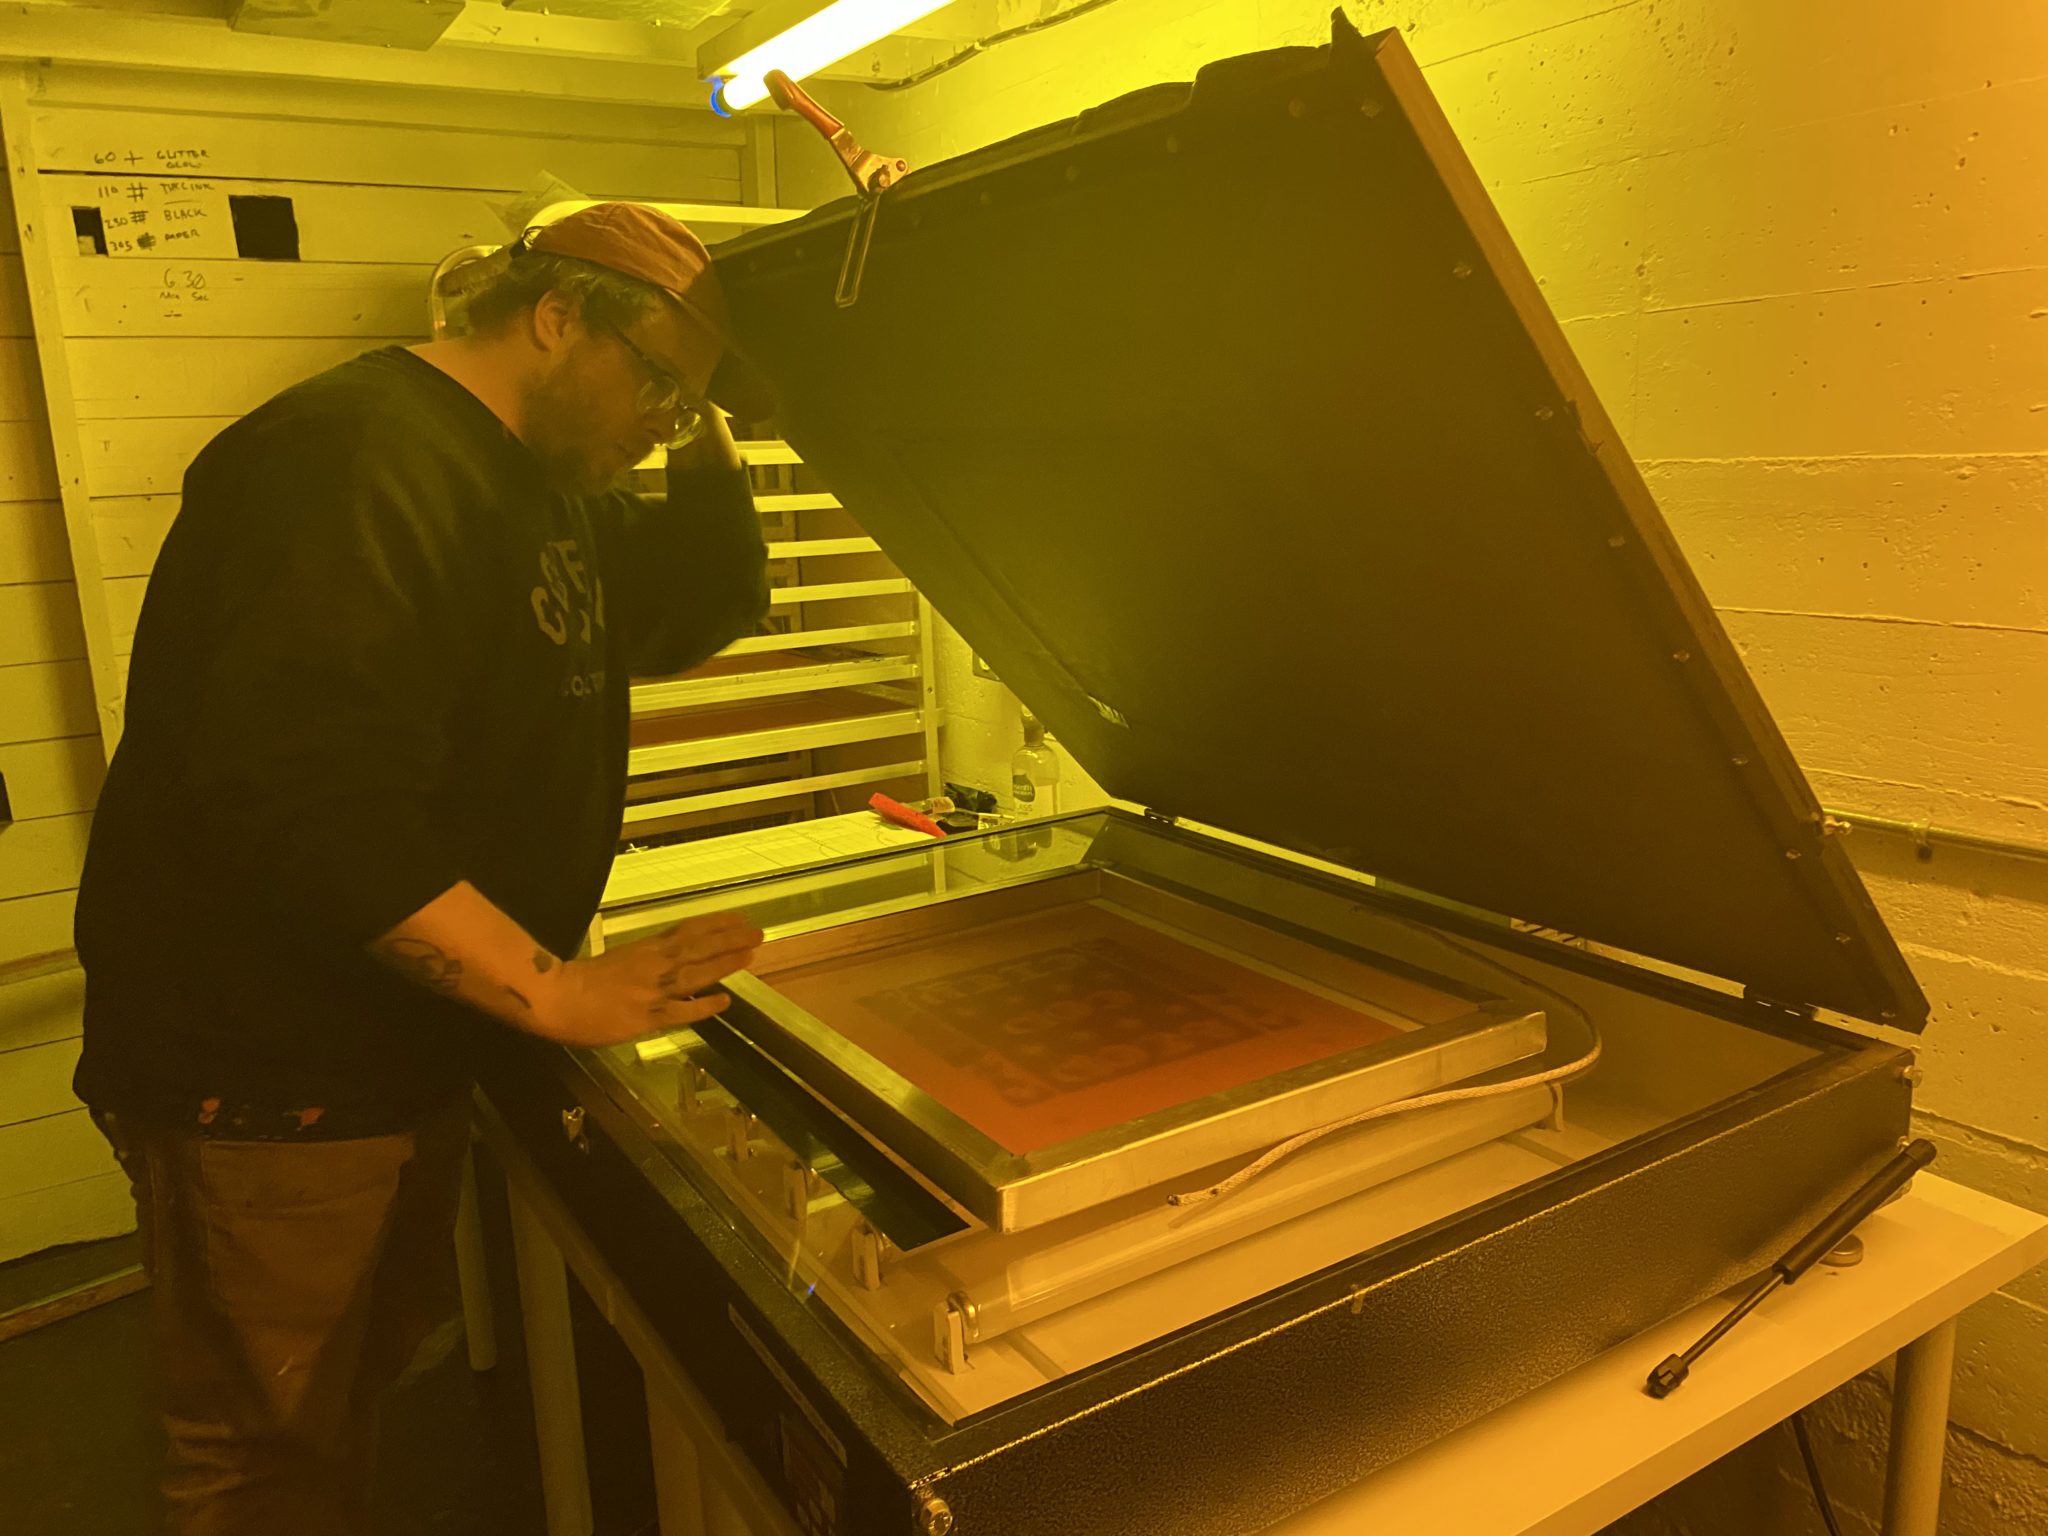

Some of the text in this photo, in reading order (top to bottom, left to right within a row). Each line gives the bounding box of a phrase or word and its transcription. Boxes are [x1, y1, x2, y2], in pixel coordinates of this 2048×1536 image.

[94, 151, 117, 165] 60
[98, 185, 119, 199] 110
[163, 208, 208, 222] BLACK
